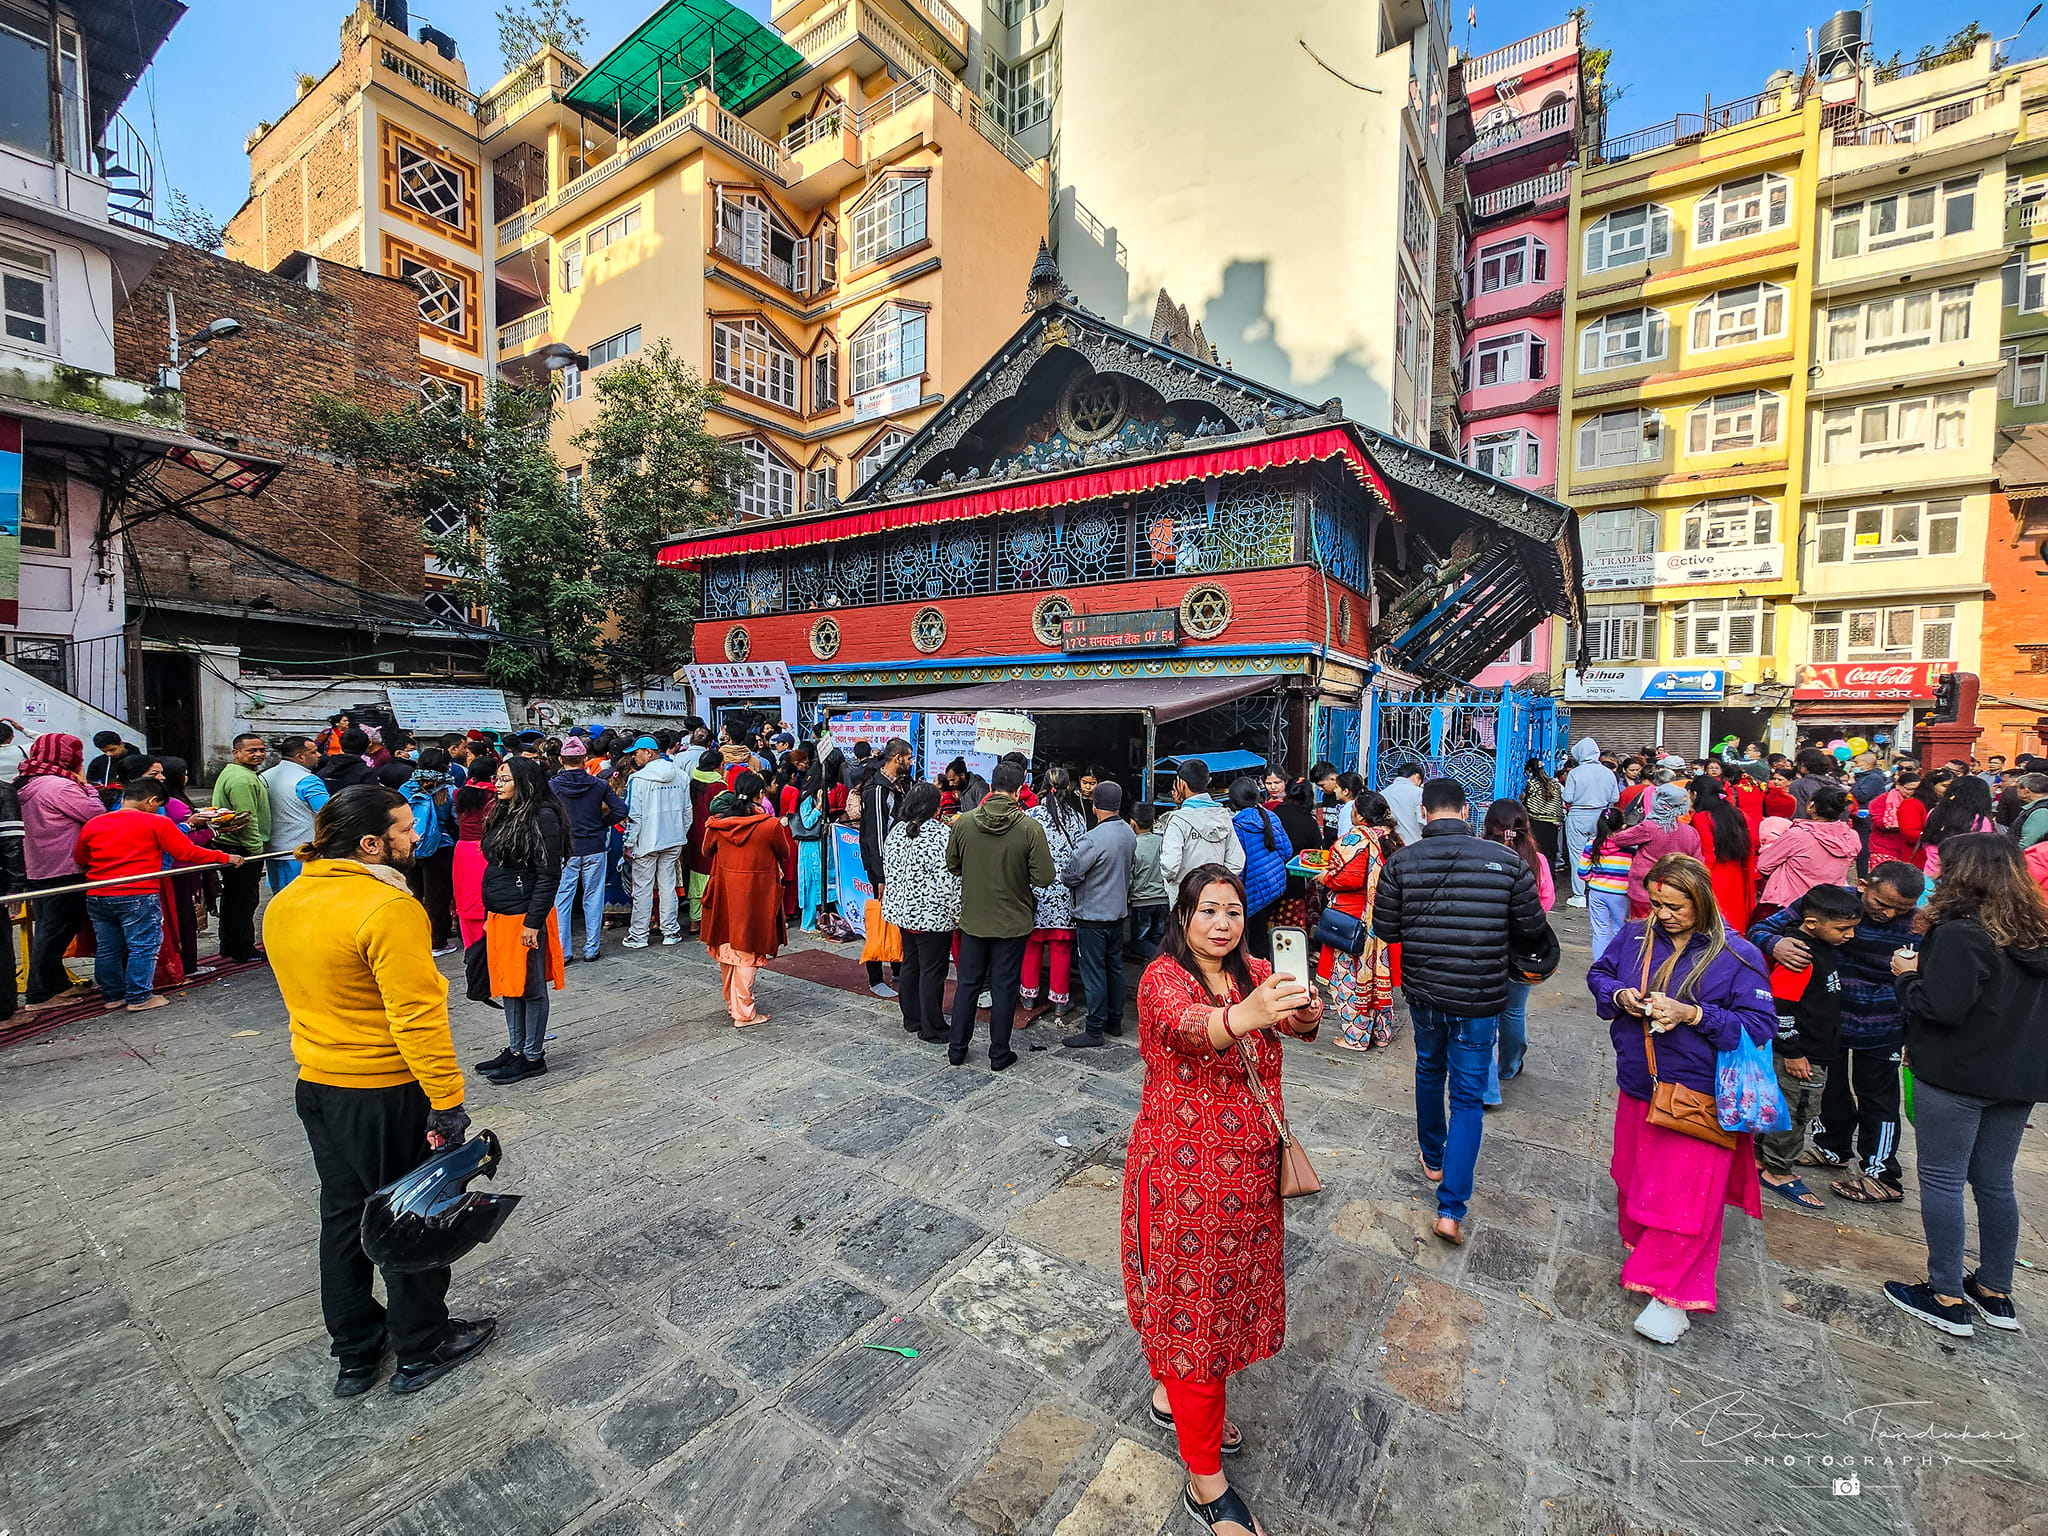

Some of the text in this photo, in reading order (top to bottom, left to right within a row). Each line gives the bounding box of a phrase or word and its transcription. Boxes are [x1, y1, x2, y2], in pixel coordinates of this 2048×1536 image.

[1600, 554, 1653, 566] TRADERS
[1667, 554, 1715, 570] @ctive
[1144, 630, 1157, 642] 07
[1823, 688, 1871, 698] गरिमा
[670, 701, 686, 711] PARTS
